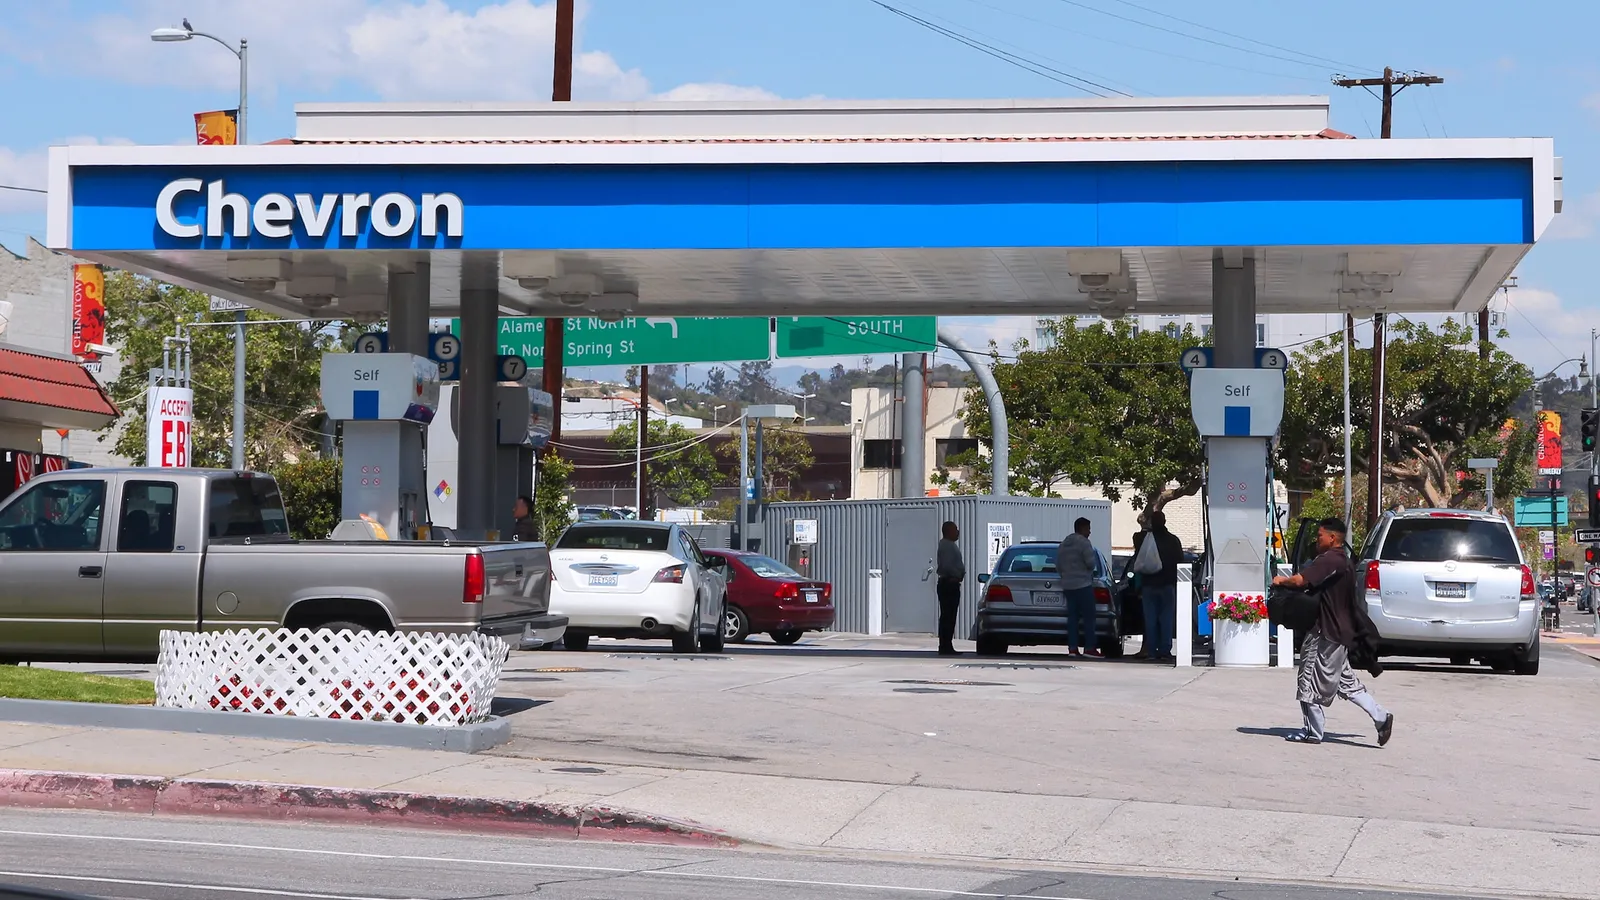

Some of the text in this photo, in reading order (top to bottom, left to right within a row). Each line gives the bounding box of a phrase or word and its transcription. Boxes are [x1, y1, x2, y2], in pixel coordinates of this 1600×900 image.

[155, 178, 464, 238] Chevron
[73, 272, 82, 348] CHINATOWN
[568, 318, 583, 331] St
[847, 319, 903, 336] SOUTH
[364, 341, 375, 353] 6
[440, 342, 452, 355] 5
[501, 344, 515, 357] To
[568, 342, 614, 359] Spring
[620, 340, 635, 353] St
[1190, 354, 1199, 366] 4
[1268, 355, 1278, 366] 3
[438, 361, 448, 374] 8
[509, 361, 519, 375] 7
[353, 369, 380, 381] Self
[1223, 384, 1251, 397] Self
